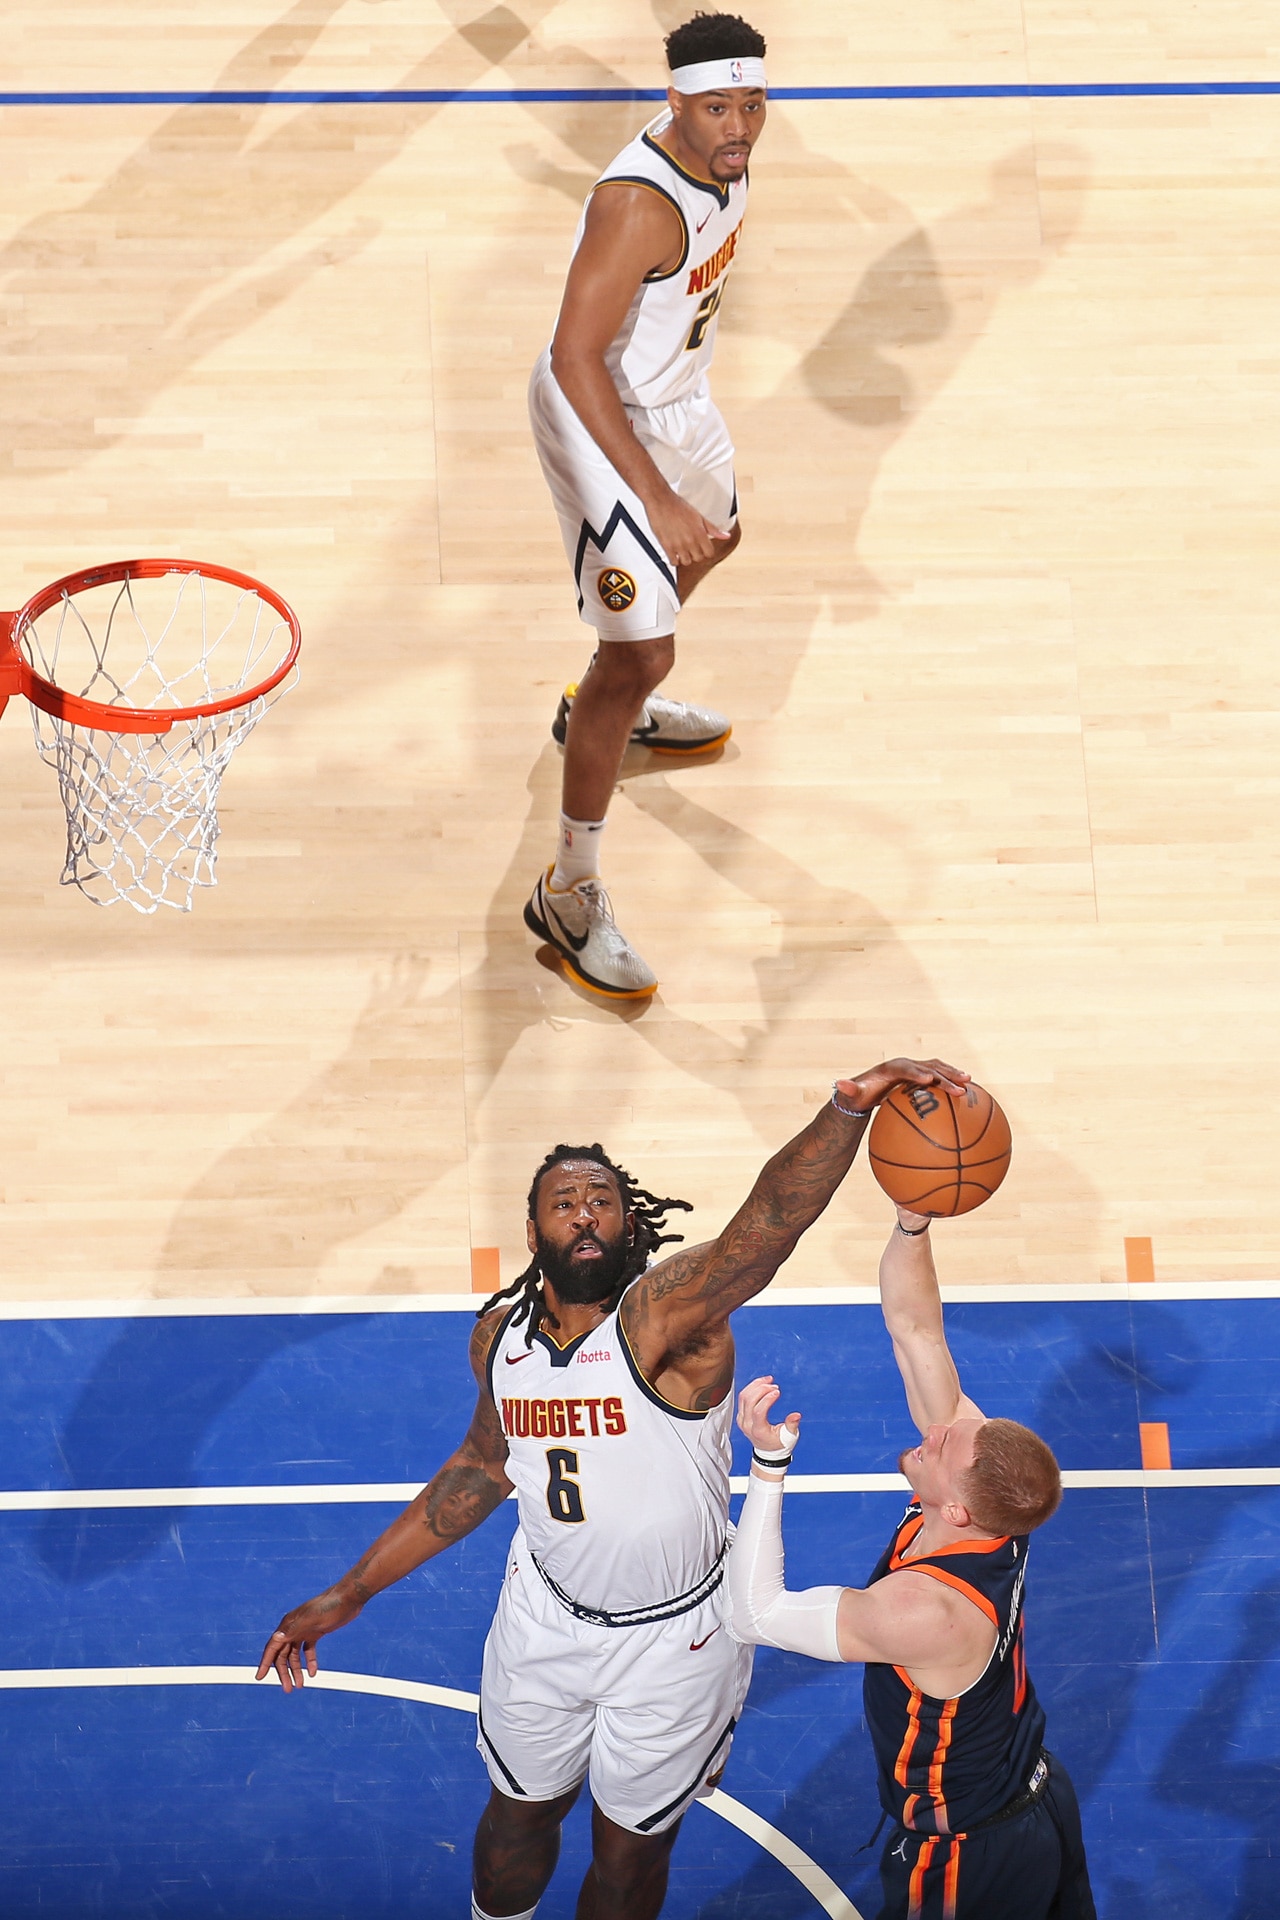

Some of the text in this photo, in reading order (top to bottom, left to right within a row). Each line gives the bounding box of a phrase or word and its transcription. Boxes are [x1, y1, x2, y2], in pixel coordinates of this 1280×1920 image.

[576, 1349, 611, 1364] ibotta
[501, 1397, 628, 1438] NUGGETS
[545, 1446, 588, 1524] 6
